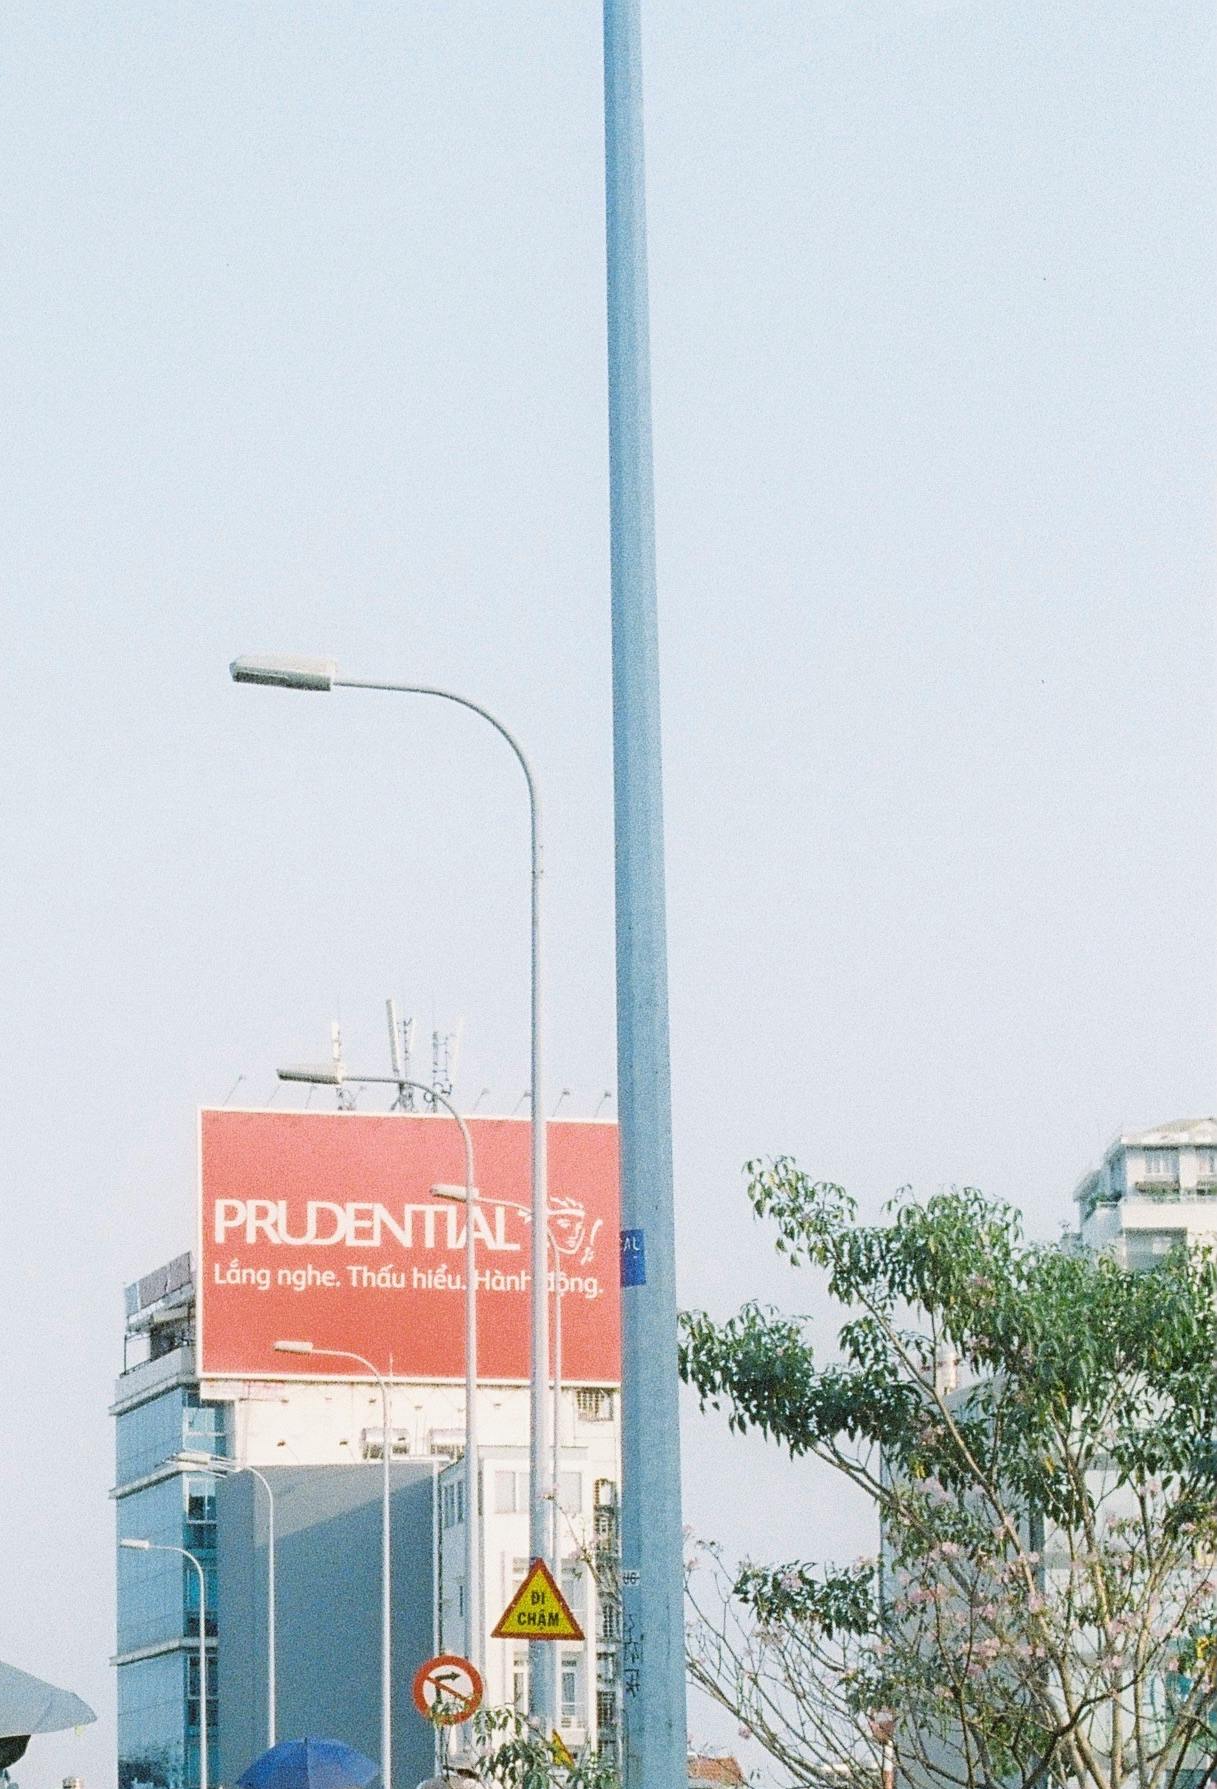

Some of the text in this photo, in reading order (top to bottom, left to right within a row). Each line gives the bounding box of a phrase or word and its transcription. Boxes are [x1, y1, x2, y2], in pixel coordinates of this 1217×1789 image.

[214, 1199, 521, 1251] PRUDENTIAL
[214, 1259, 271, 1291] Lắng
[277, 1264, 341, 1292] nghe.
[346, 1263, 406, 1289] Thấu
[412, 1263, 467, 1291] hiểu.
[531, 1590, 545, 1606] ĐI
[517, 1609, 559, 1630] CHẬM
